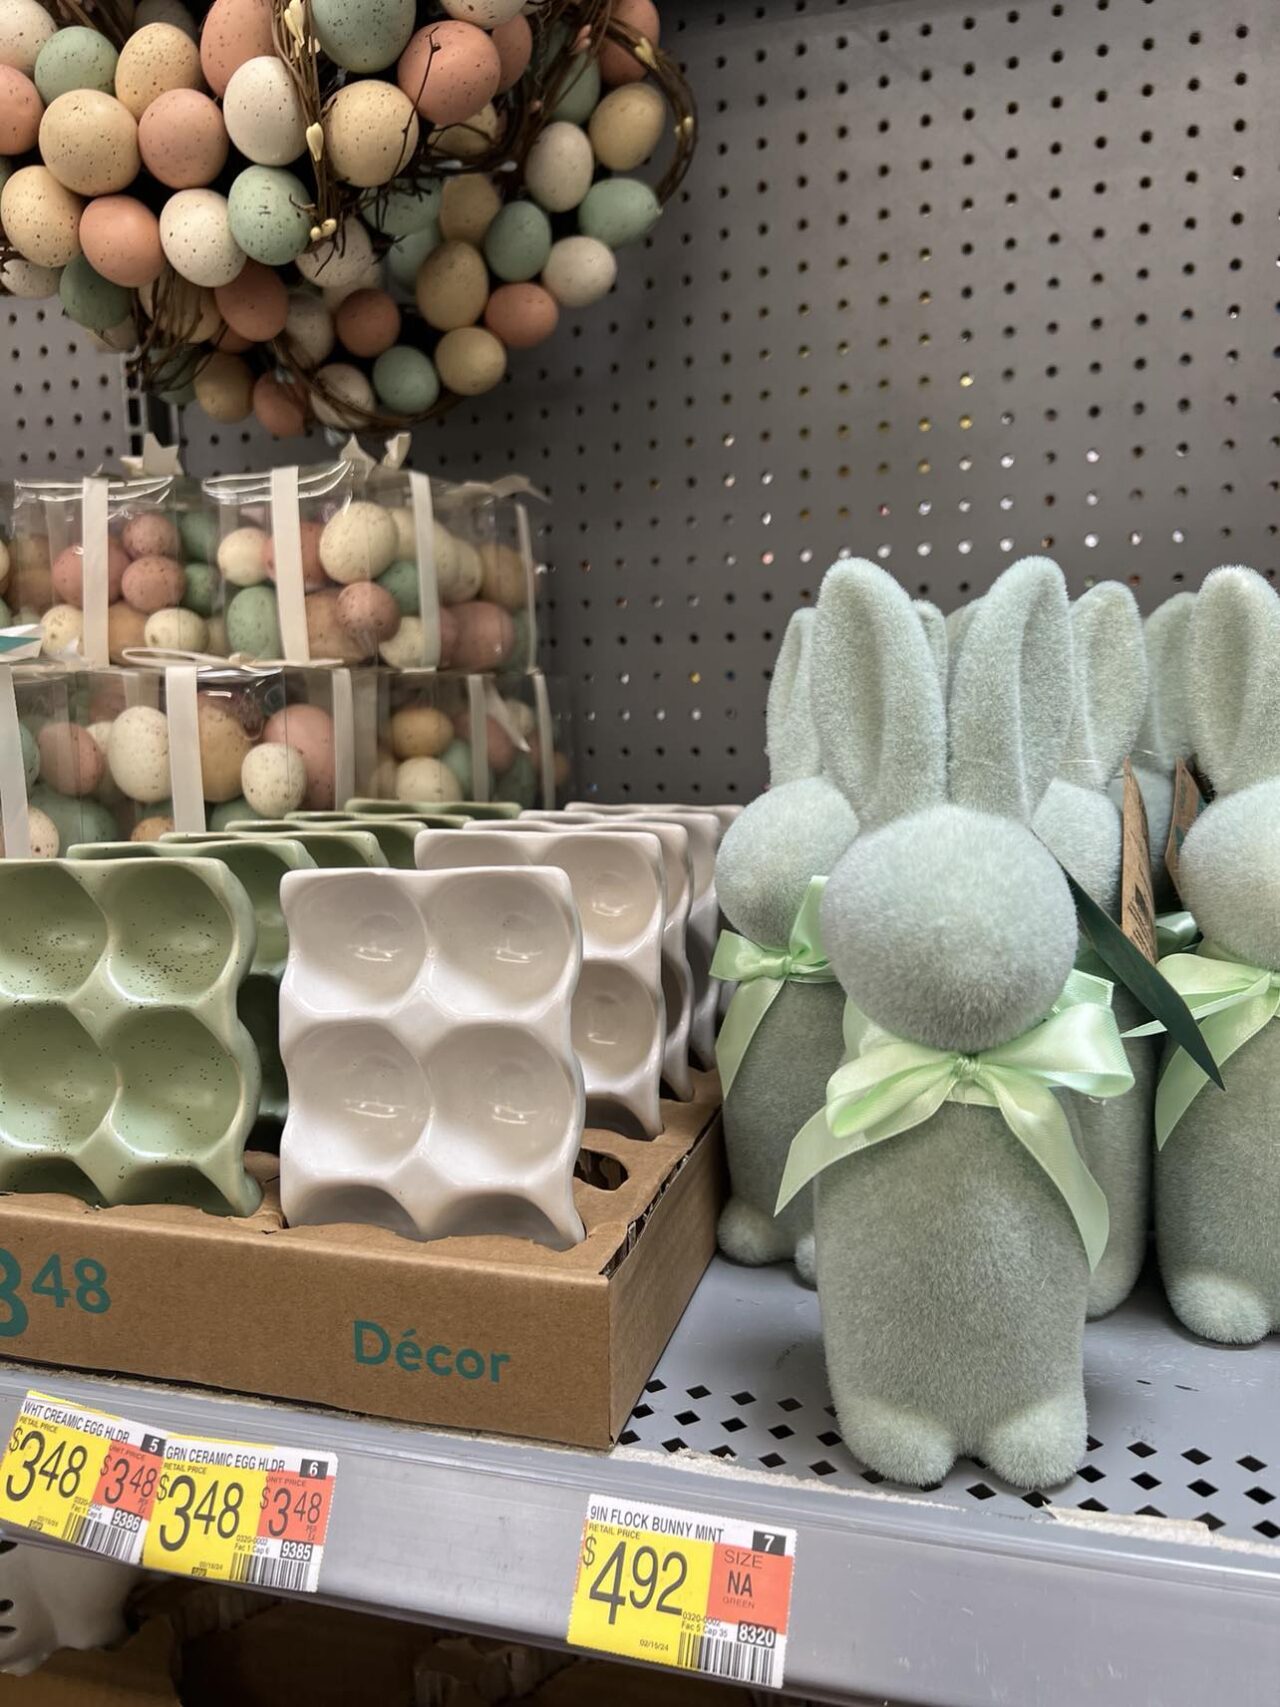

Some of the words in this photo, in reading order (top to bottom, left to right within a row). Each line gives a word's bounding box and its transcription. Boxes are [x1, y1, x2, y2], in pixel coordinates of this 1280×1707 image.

[353, 1320, 510, 1383] Décor
[19, 1416, 39, 1428] RETAIL
[40, 1423, 58, 1434] PRICE
[23, 1401, 46, 1420] WHT
[43, 1408, 82, 1430] CREAMIC
[83, 1420, 104, 1436] EGG
[104, 1427, 130, 1444] HLDR
[149, 1438, 160, 1453] 5
[166, 1446, 187, 1460] GRN
[188, 1449, 233, 1467] CERAMIC
[234, 1456, 256, 1469] EGG
[258, 1458, 285, 1472] HLDR
[164, 1462, 186, 1472] RETAIL
[187, 1466, 208, 1475] PRICE
[309, 1462, 319, 1477] 6
[284, 1478, 306, 1487] PRICE
[113, 1508, 141, 1532] 9386
[590, 1506, 608, 1522] 9IN
[610, 1510, 649, 1530] FLOCK
[652, 1516, 693, 1536] BUNNY
[695, 1525, 724, 1543] MINT
[588, 1522, 615, 1535] RETAIL
[617, 1528, 641, 1540] PRICE
[282, 1541, 311, 1560] 9385
[763, 1534, 775, 1552] 7
[724, 1550, 764, 1570] SIZE
[727, 1571, 753, 1597] NA
[722, 1596, 755, 1610] GREEN
[682, 1611, 721, 1627] 0320-0002
[681, 1621, 695, 1632] Fac
[703, 1624, 717, 1638] Cap
[719, 1628, 729, 1638] 35
[738, 1623, 774, 1647] 8320
[639, 1638, 669, 1652] 02/15/24
